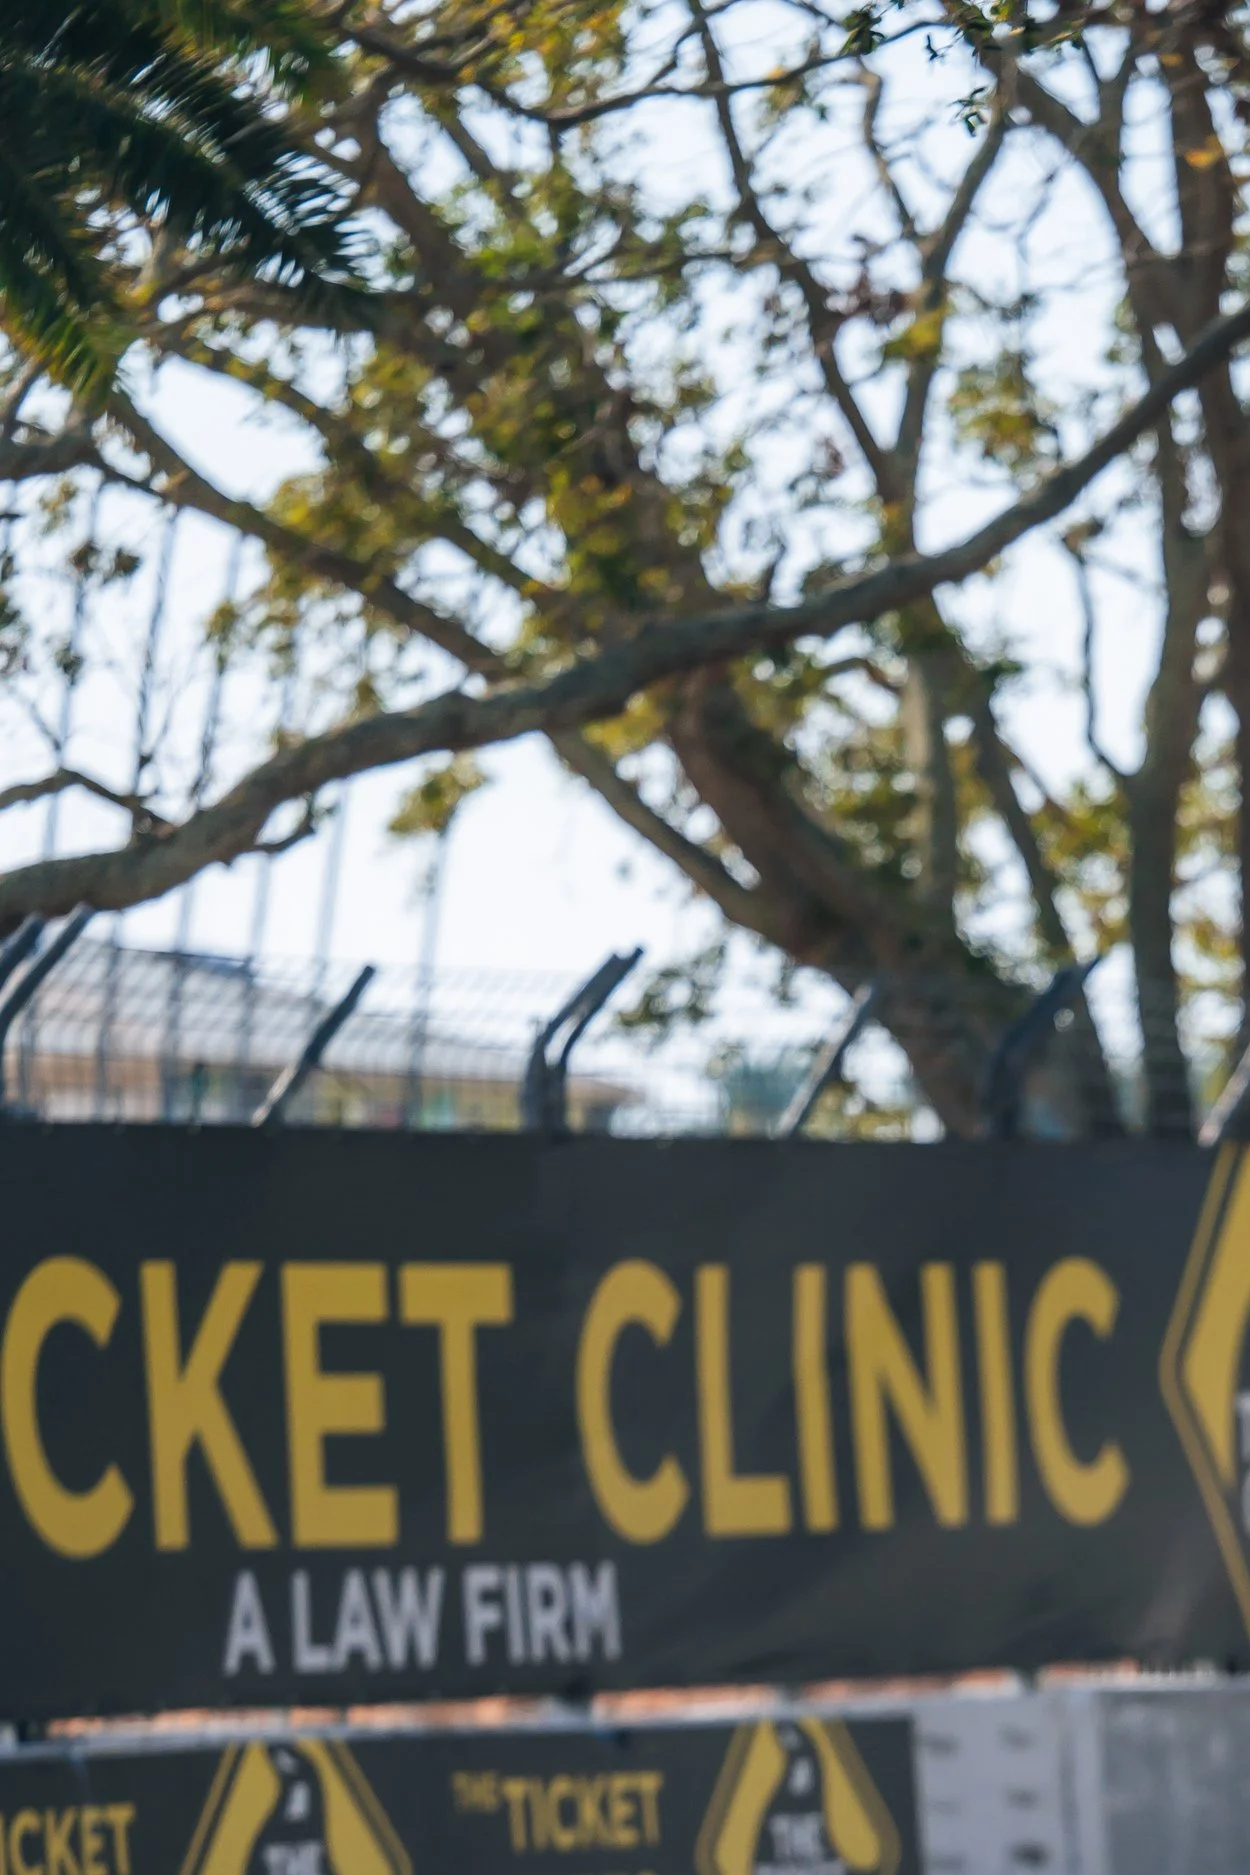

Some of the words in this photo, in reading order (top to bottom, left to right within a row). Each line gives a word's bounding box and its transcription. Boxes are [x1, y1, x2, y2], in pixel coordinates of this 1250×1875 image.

[1, 1254, 515, 1560] CKET
[574, 1255, 1131, 1546] CLINIC
[224, 1570, 275, 1676] A
[292, 1566, 445, 1674] LAW
[461, 1560, 622, 1666] FIRM
[502, 1771, 664, 1852] TICKET
